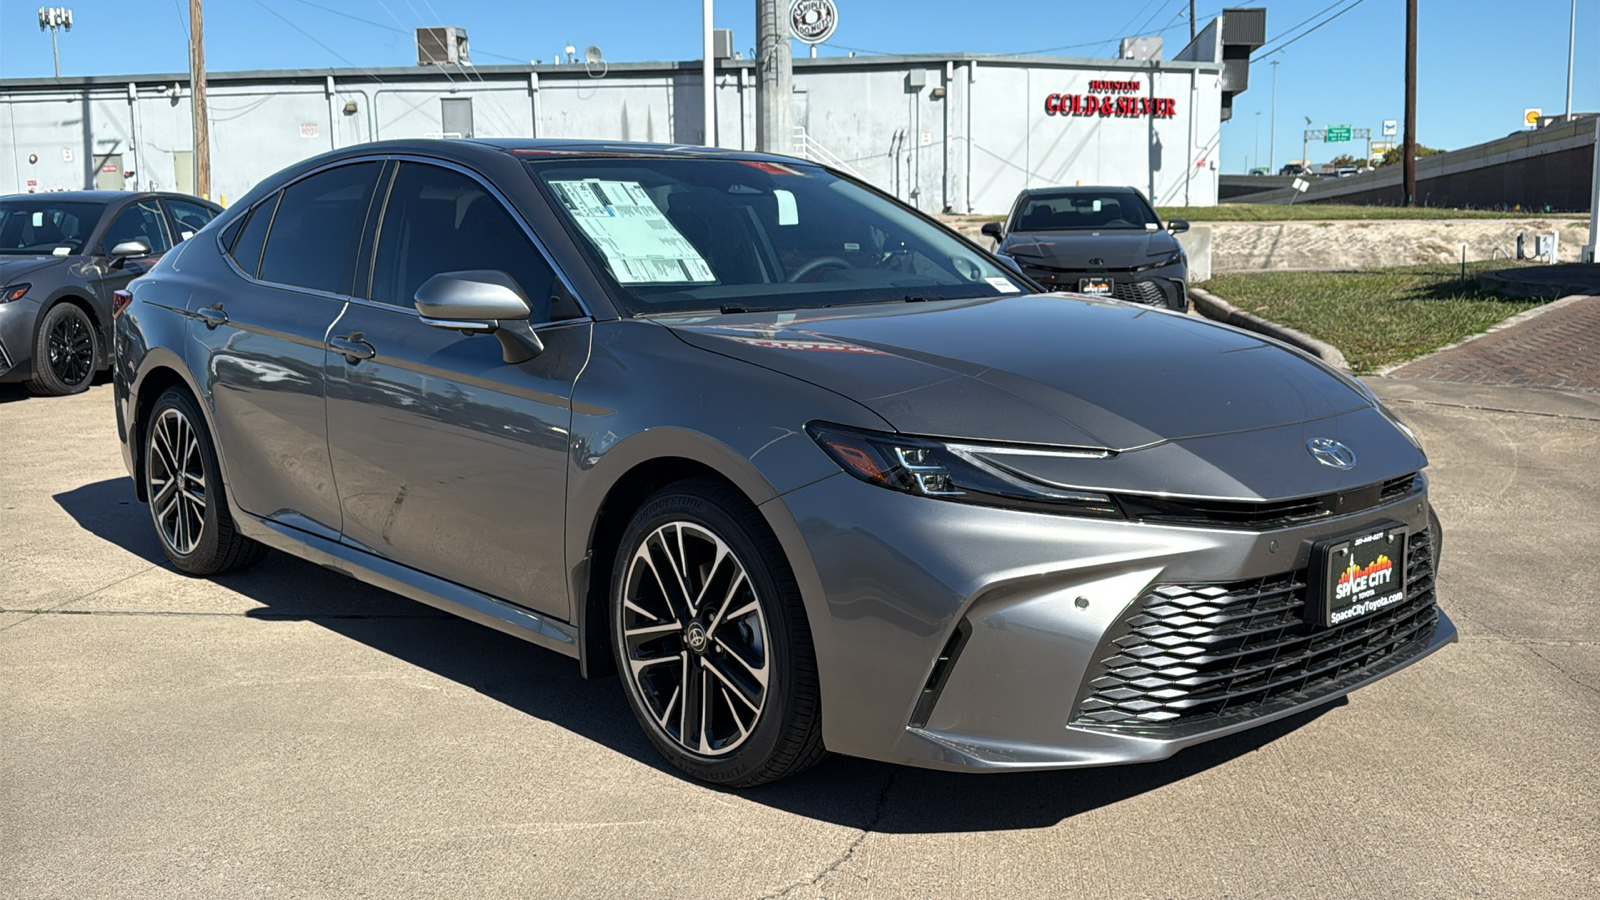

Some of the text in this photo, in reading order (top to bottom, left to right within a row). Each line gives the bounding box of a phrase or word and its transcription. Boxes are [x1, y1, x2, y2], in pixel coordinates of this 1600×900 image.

[795, 1, 828, 17] SHIPLEY
[1091, 80, 1140, 91] HOUSTON
[1335, 567, 1393, 599] SPACE CITY
[1358, 589, 1376, 600] TOYOTA
[1331, 591, 1403, 624] SpaceCityToyota.com
